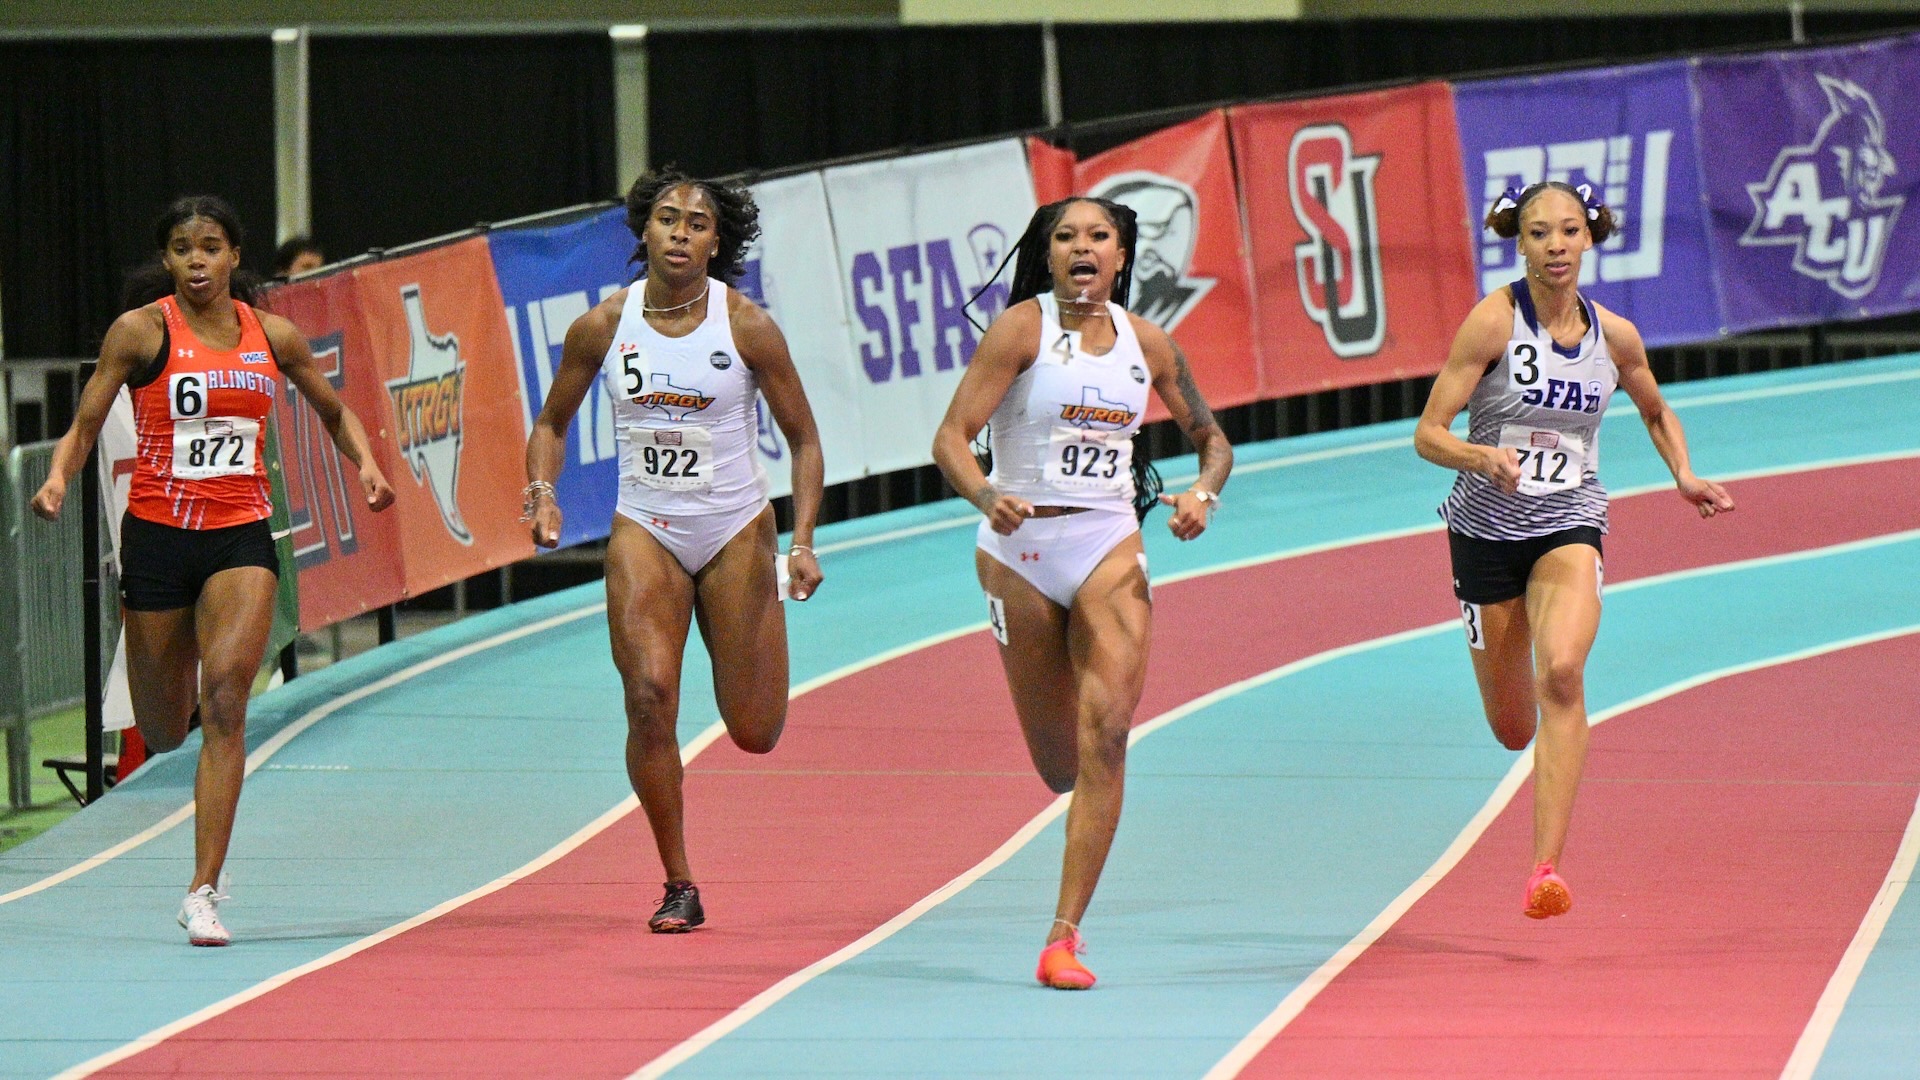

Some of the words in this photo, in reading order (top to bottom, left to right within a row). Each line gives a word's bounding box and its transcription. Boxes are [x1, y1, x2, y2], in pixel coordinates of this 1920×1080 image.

[1764, 161, 1887, 283] ACU
[852, 238, 978, 384] SFA
[1051, 332, 1074, 366] 4
[1513, 343, 1540, 386] 3
[623, 352, 643, 395] 5
[176, 376, 202, 416] 6
[1059, 403, 1139, 427] UTRGV
[189, 435, 244, 467] 872
[643, 446, 699, 478] 922
[1061, 445, 1119, 479] 923
[1463, 602, 1478, 644] 3
